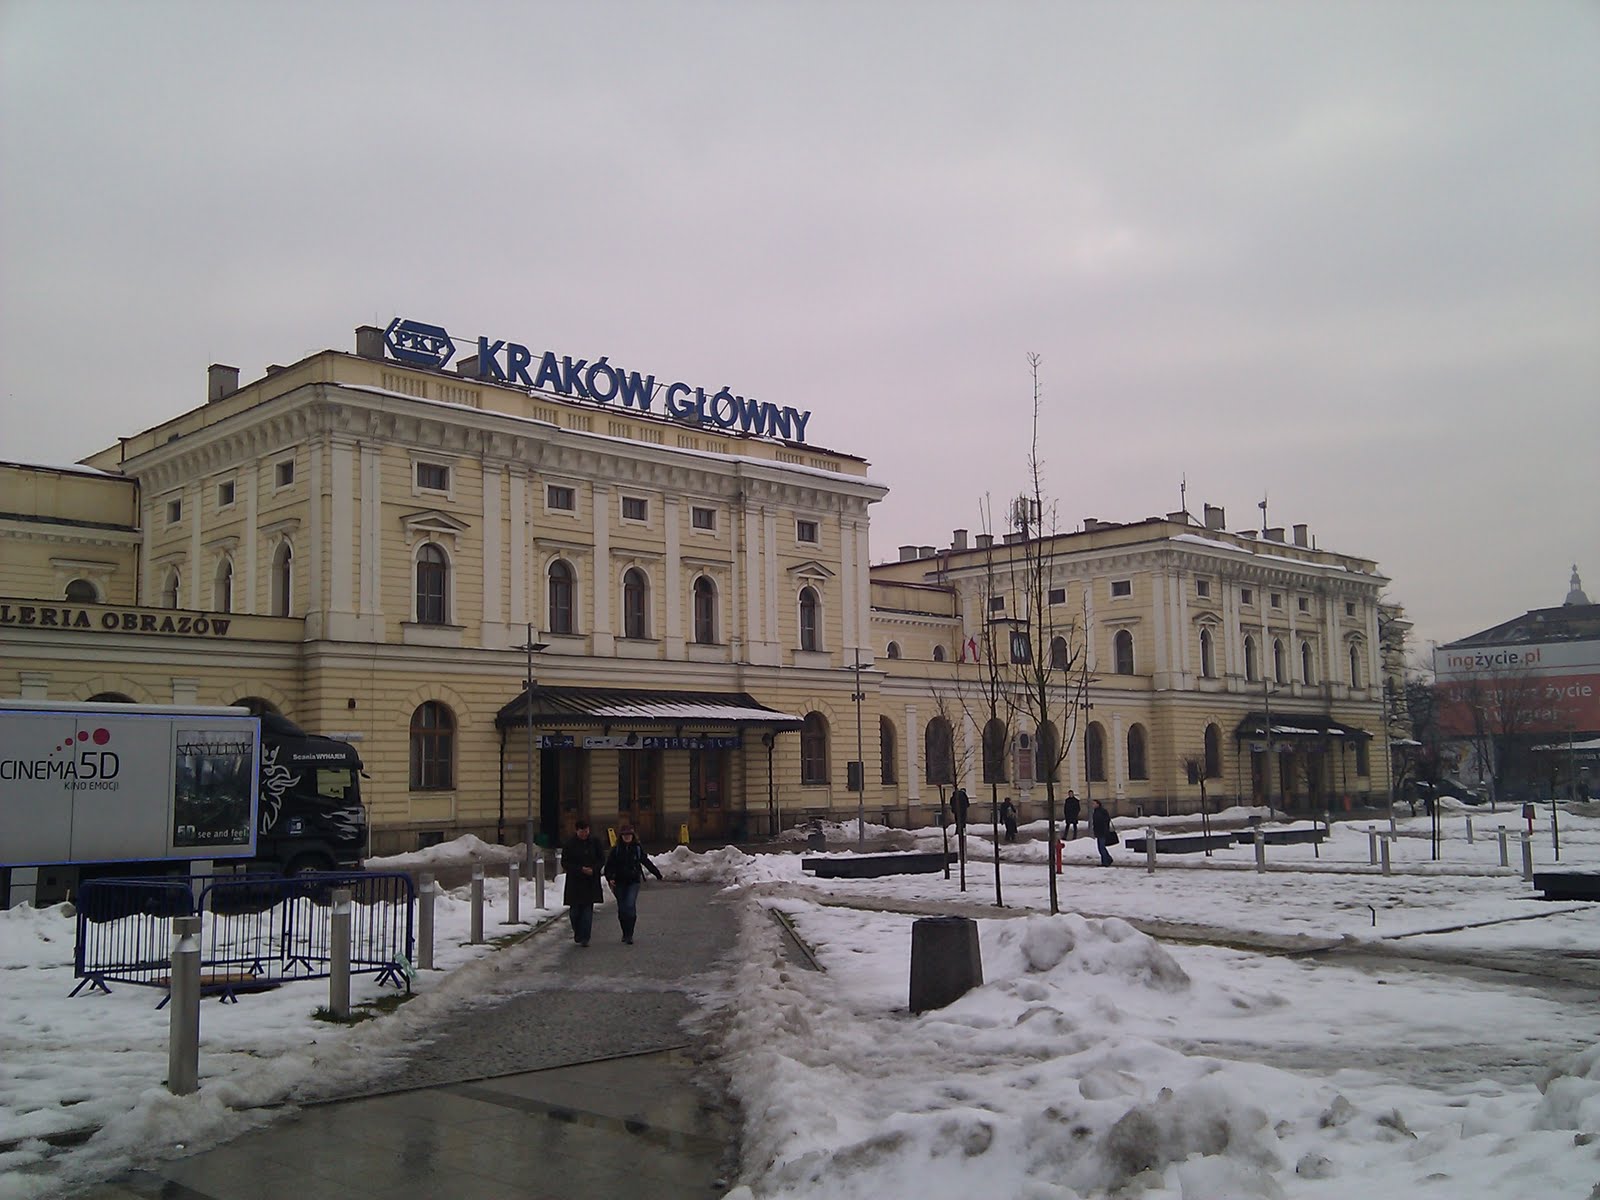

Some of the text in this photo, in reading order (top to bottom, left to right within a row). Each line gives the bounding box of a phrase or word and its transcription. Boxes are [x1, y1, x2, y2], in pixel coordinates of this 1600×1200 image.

[396, 328, 451, 355] PKP
[478, 335, 811, 441] KRAKÓW GŁÓWNY
[102, 612, 231, 637] OBRAZÓW
[1447, 648, 1541, 670] ingżycie.pl
[1545, 682, 1592, 702] życie
[64, 781, 87, 790] KINO
[197, 831, 211, 839] see
[213, 829, 228, 838] and
